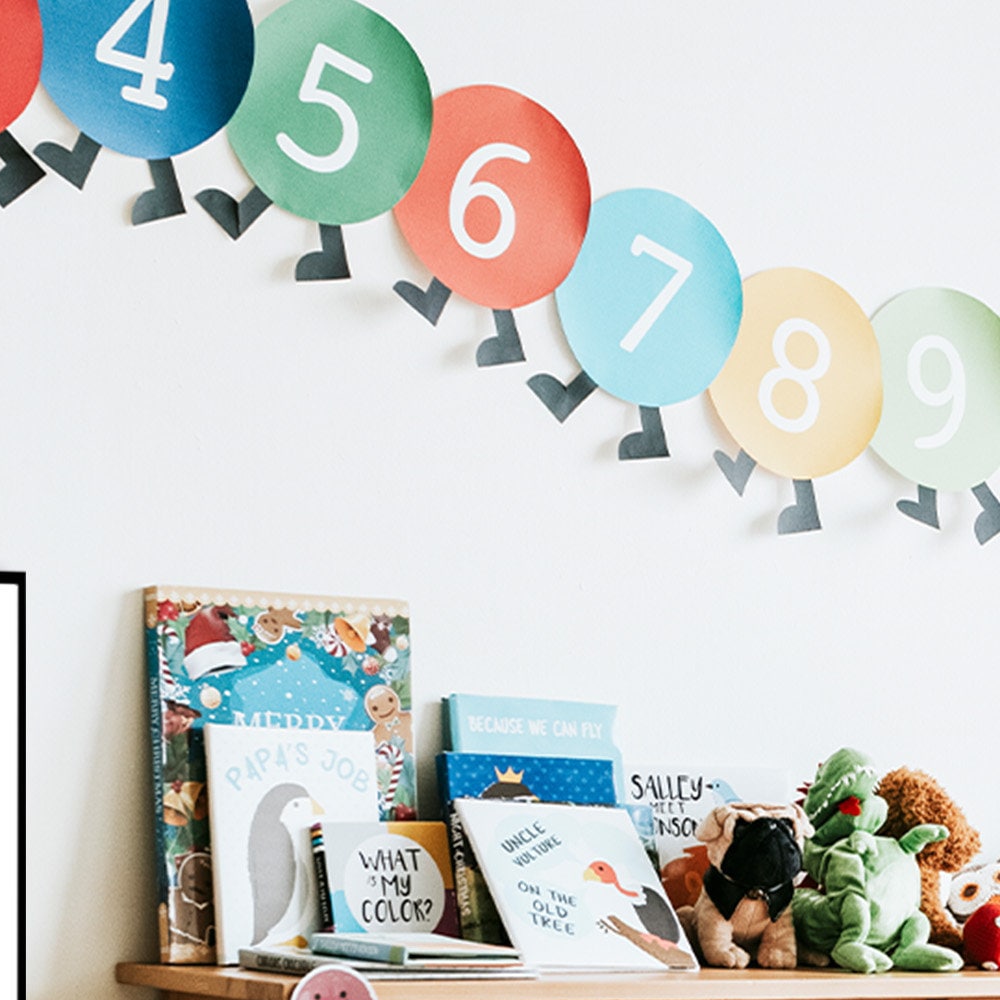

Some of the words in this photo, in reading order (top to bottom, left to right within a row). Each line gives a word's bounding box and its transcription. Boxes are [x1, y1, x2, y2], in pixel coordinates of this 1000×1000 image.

[95, 0, 175, 111] 4
[276, 43, 373, 173] 5
[449, 143, 531, 259] 6
[620, 234, 693, 353] 7
[758, 318, 831, 433] 8
[907, 335, 966, 450] 9
[468, 715, 523, 735] BECAUSE
[528, 718, 548, 735] WE
[553, 720, 578, 737] CAN
[580, 721, 603, 740] FLY
[225, 742, 309, 791] PAPA'S
[320, 749, 370, 793] JOB
[631, 774, 703, 801] SALLEY
[501, 821, 546, 854] UNCLE
[512, 834, 562, 868] VULTURE
[359, 848, 421, 872] WHAT
[381, 874, 411, 897] MY
[518, 881, 540, 895] ON
[549, 889, 577, 907] THE
[362, 898, 433, 923] COLOR?
[529, 912, 575, 936] TREE
[532, 899, 569, 919] OLD
